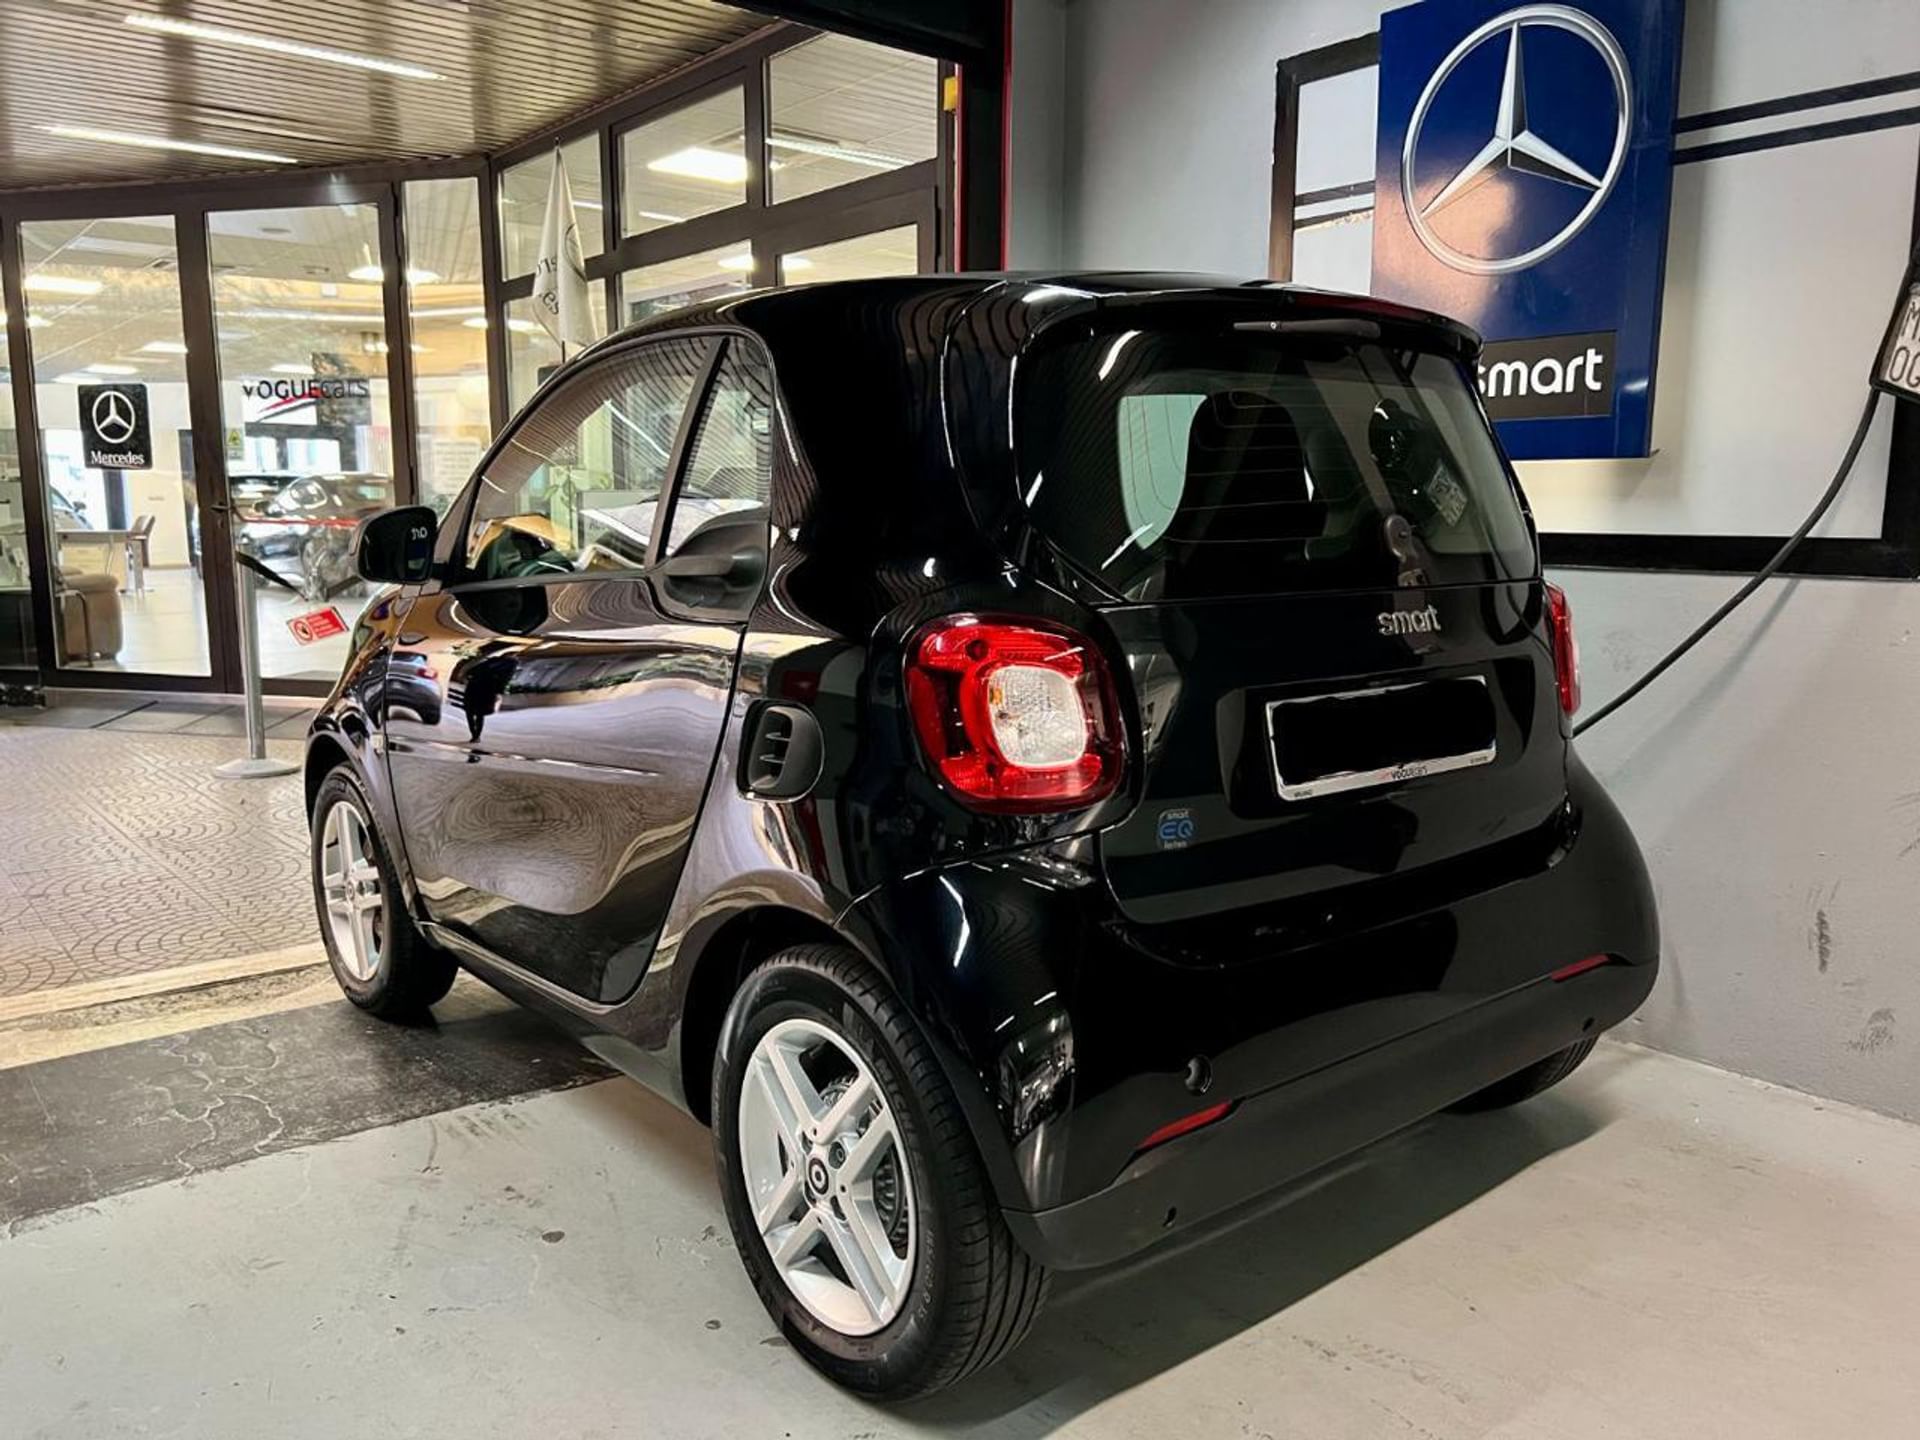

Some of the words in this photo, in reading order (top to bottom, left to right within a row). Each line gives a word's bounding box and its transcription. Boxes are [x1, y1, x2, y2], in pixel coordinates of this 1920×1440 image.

[1900, 300, 1920, 340] M
[90, 450, 145, 465] Mercedes
[1378, 604, 1441, 635] smart
[1159, 820, 1193, 839] EQ
